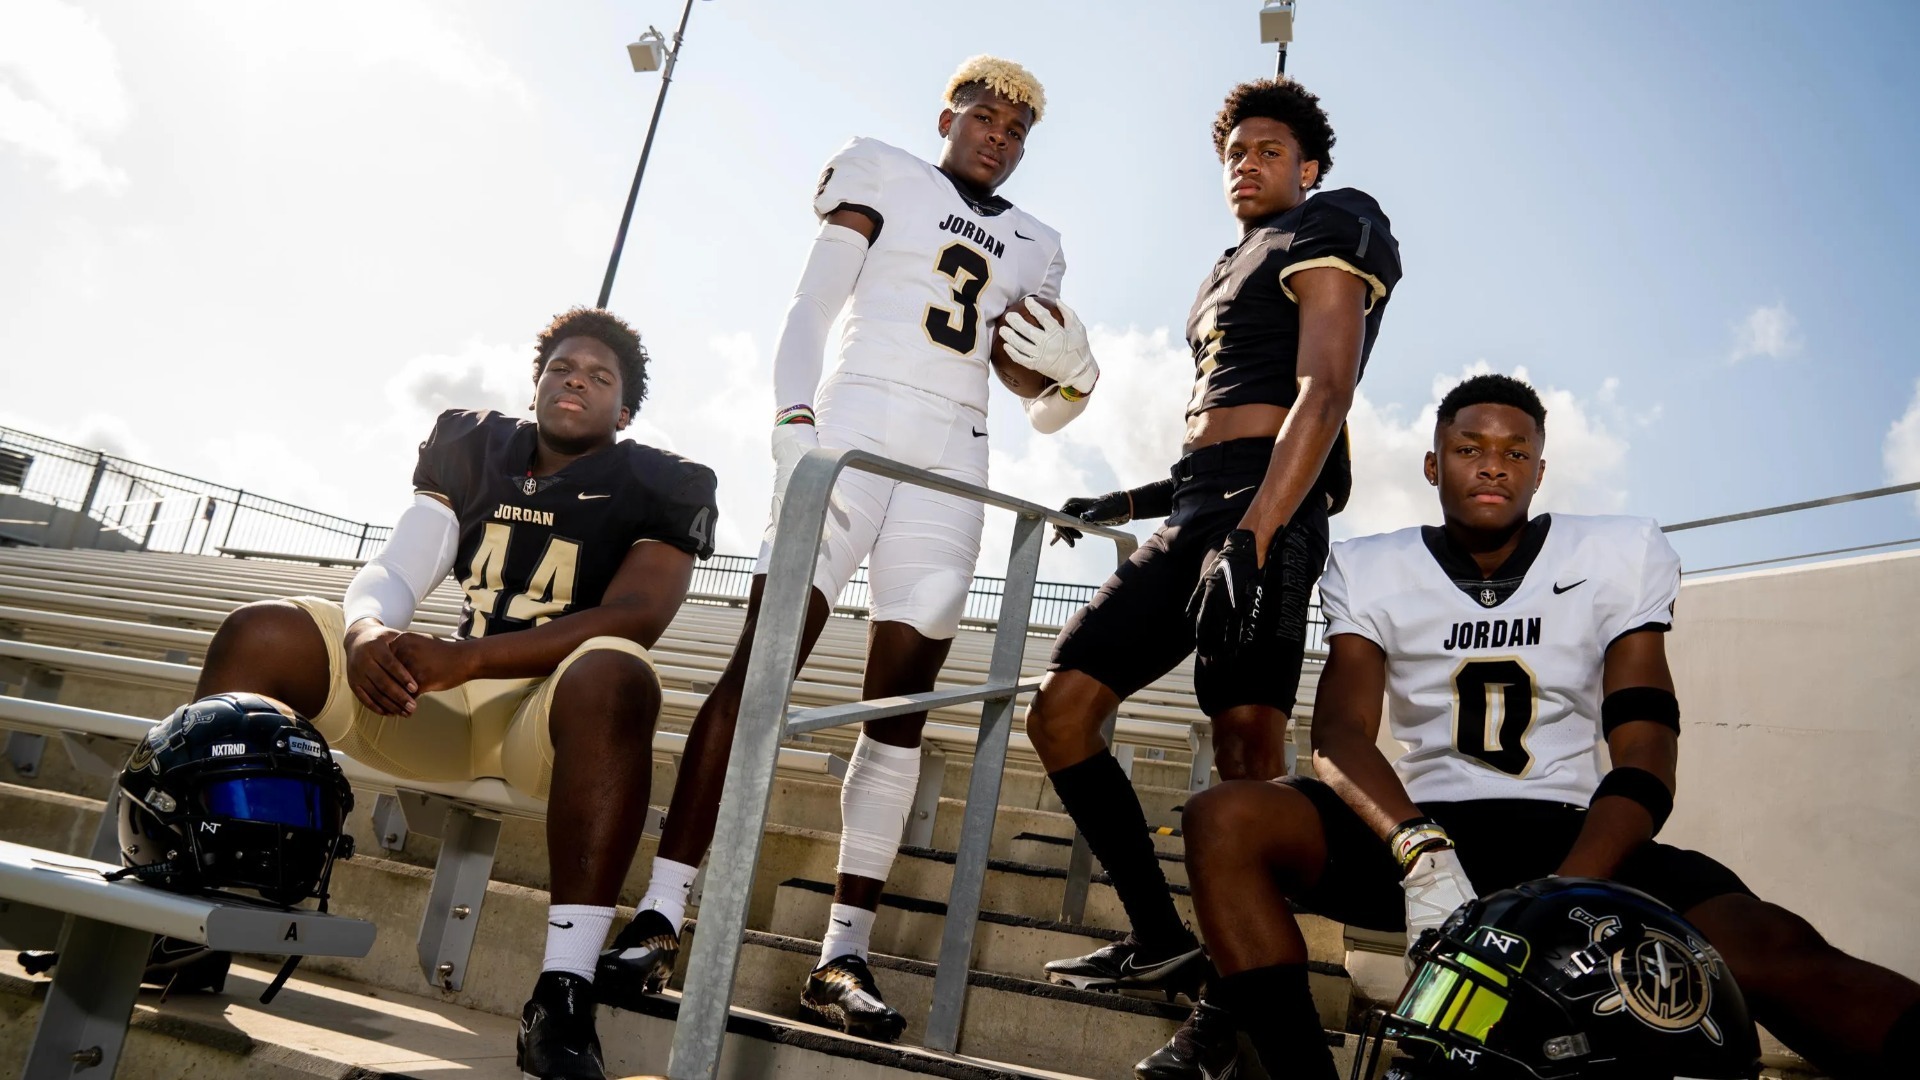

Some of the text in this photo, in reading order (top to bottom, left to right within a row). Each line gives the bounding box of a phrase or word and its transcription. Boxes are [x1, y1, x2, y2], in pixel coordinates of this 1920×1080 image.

[939, 214, 1005, 259] JORDAN
[1355, 217, 1371, 258] 1
[920, 239, 993, 357] 3
[494, 503, 554, 526] JORDAN
[461, 520, 584, 639] 44
[1443, 617, 1542, 651] JORDAN
[1450, 655, 1538, 780] 0
[211, 743, 246, 757] NXTRND
[291, 740, 320, 754] schutt
[284, 921, 298, 941] A
